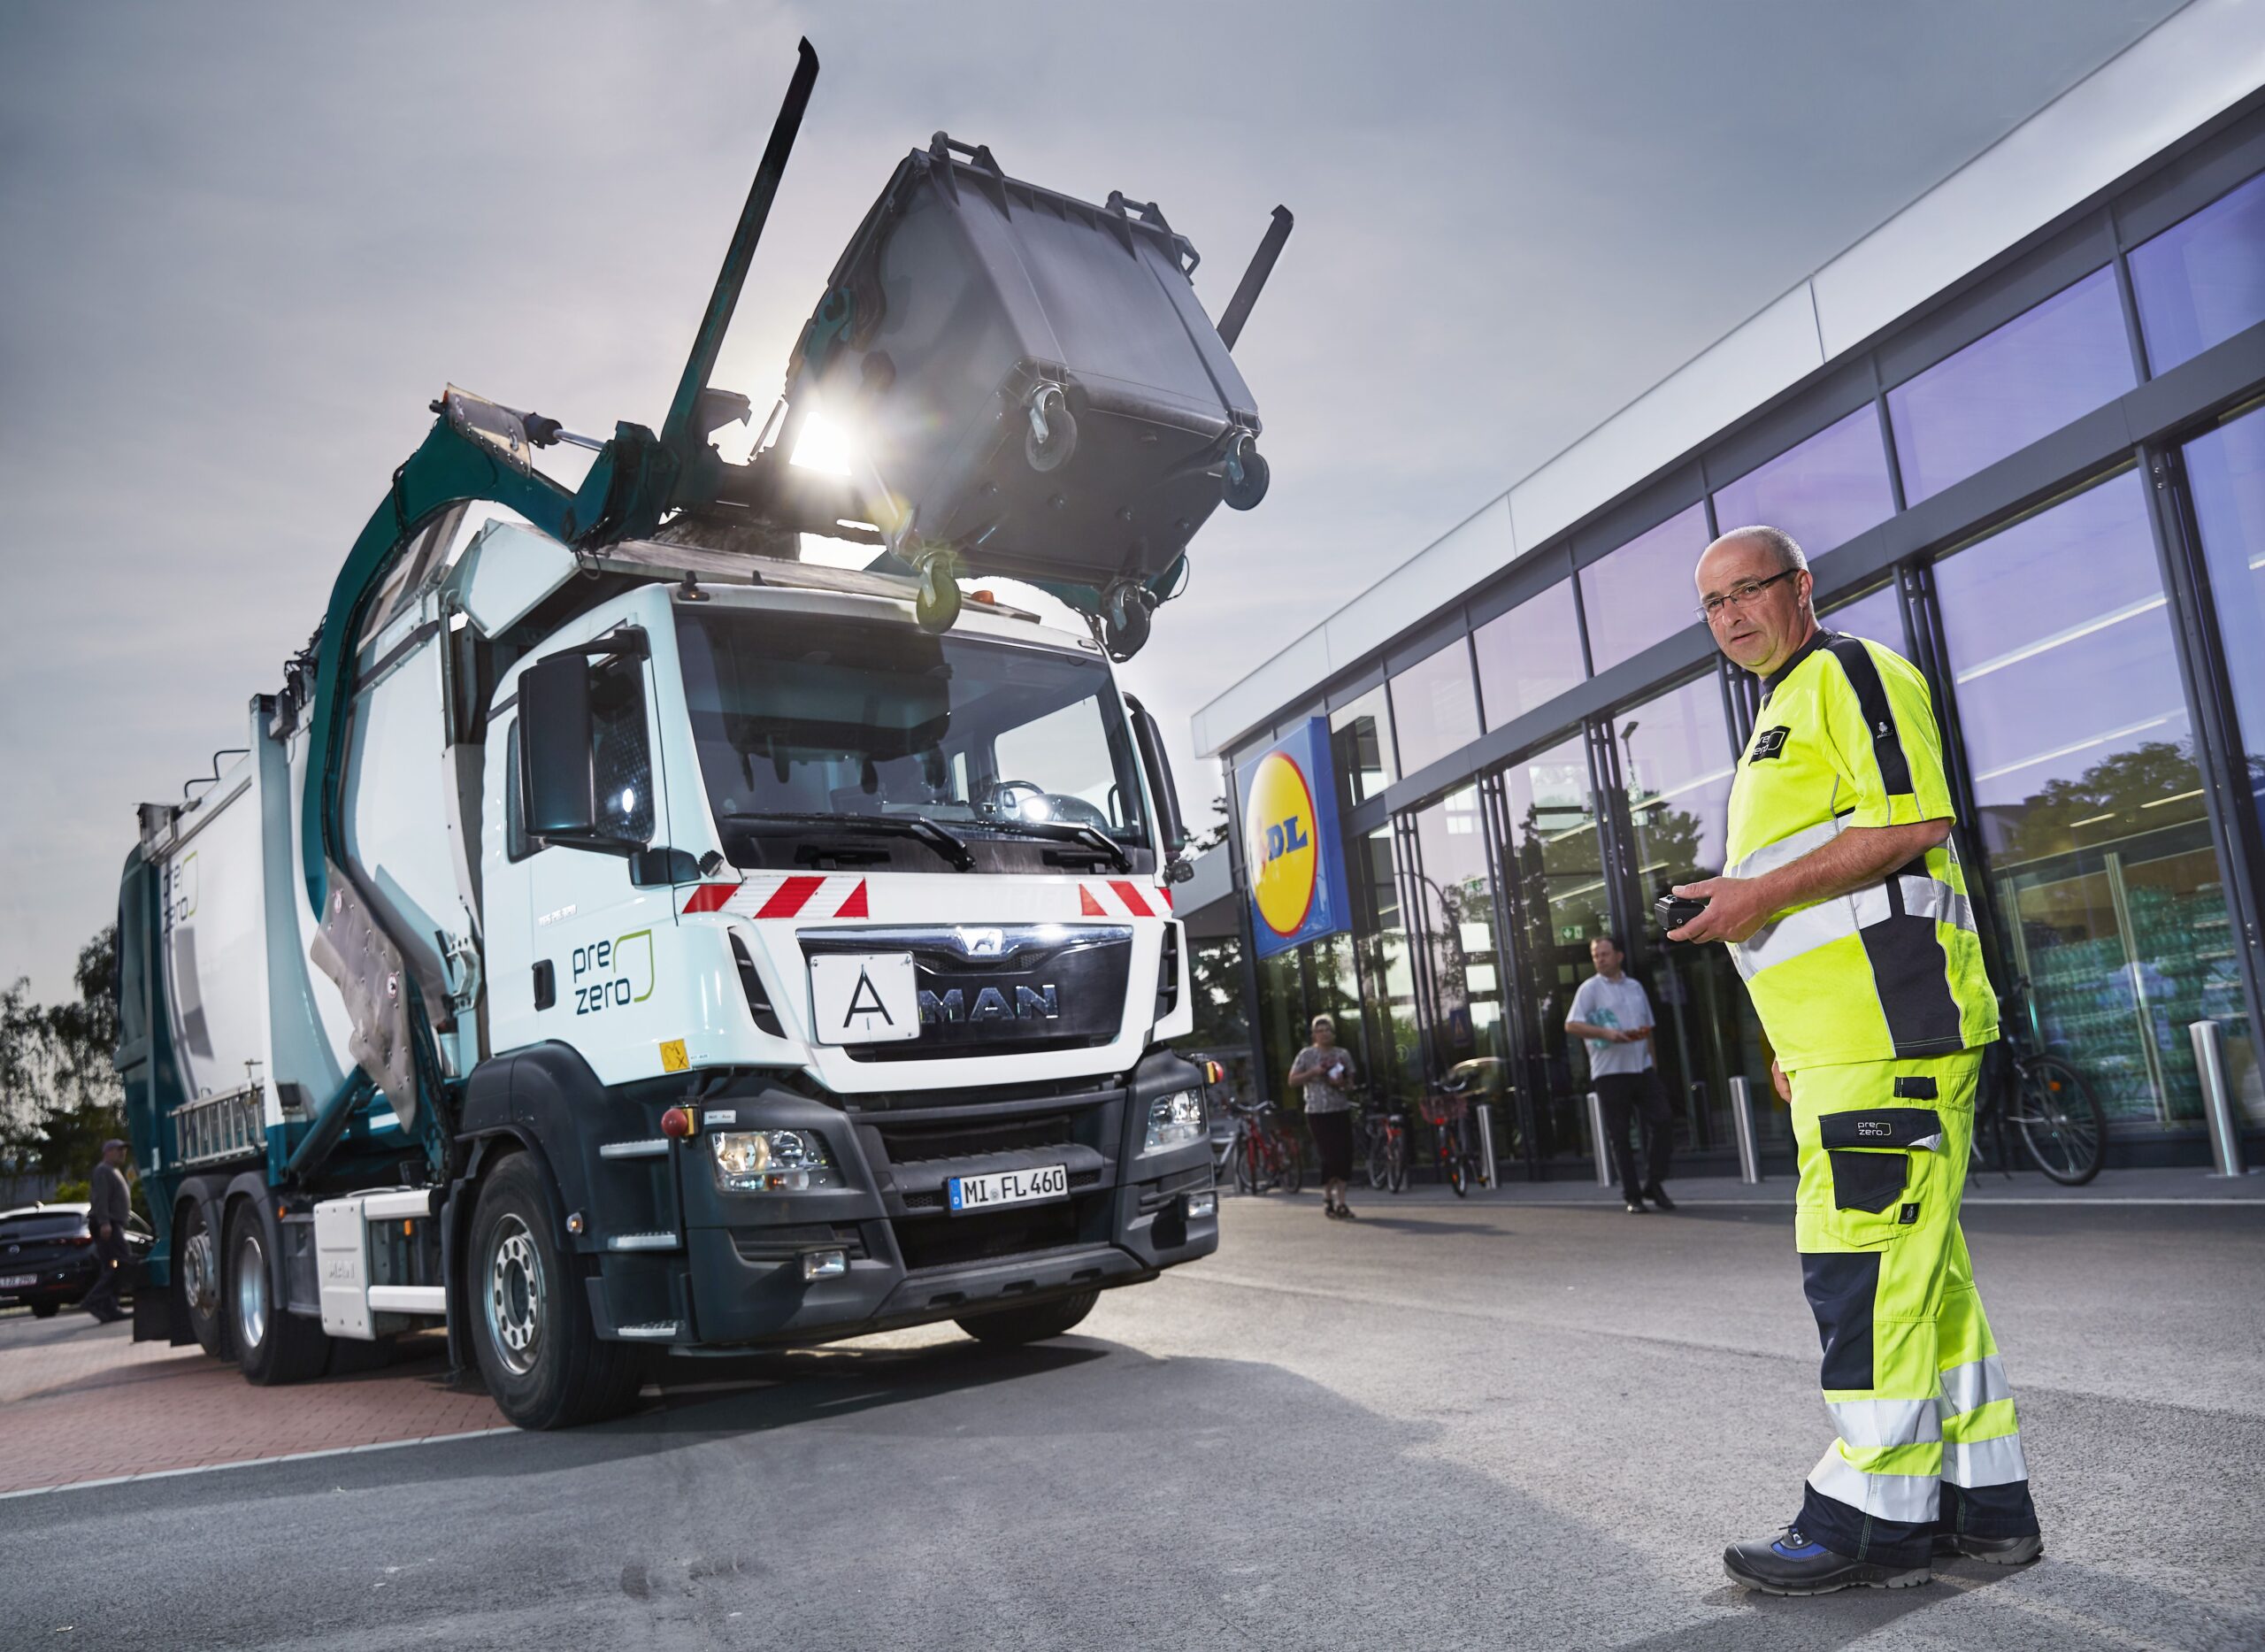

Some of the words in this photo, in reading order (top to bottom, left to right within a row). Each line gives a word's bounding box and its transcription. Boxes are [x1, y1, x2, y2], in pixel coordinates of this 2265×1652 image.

[1260, 815, 1309, 869] DL
[572, 940, 610, 984] pre
[575, 978, 631, 1015] zero
[842, 971, 894, 1028] A
[918, 984, 1059, 1024] MAN
[964, 1179, 989, 1204] MI
[1001, 1175, 1026, 1199] FL
[1031, 1169, 1064, 1195] 460
